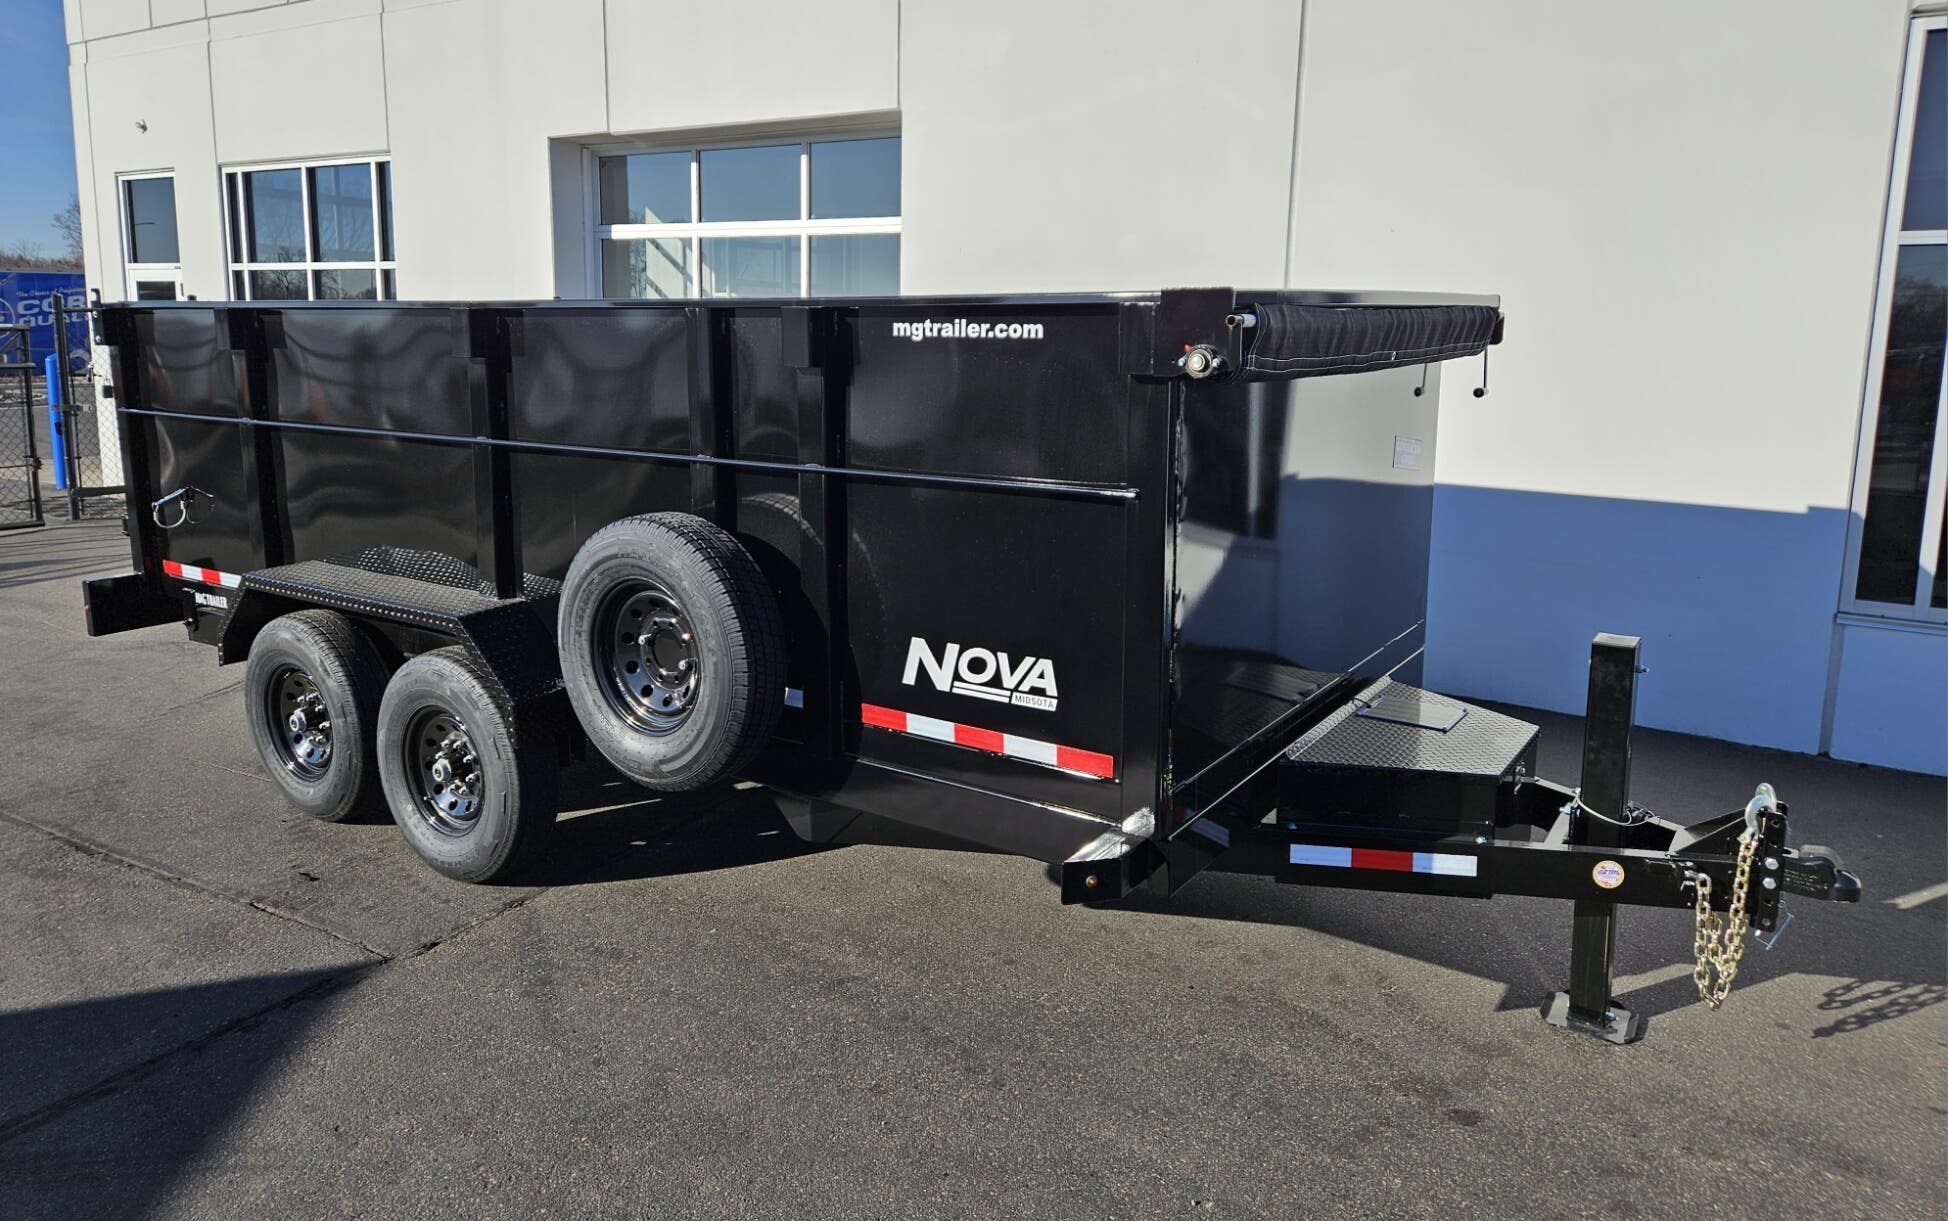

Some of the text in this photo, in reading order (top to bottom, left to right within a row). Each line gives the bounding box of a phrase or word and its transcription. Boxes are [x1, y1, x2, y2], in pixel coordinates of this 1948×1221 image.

[892, 319, 1044, 341] mgtrailer.com
[902, 636, 1058, 697] NOVA
[1014, 695, 1055, 709] MIDSOTA
